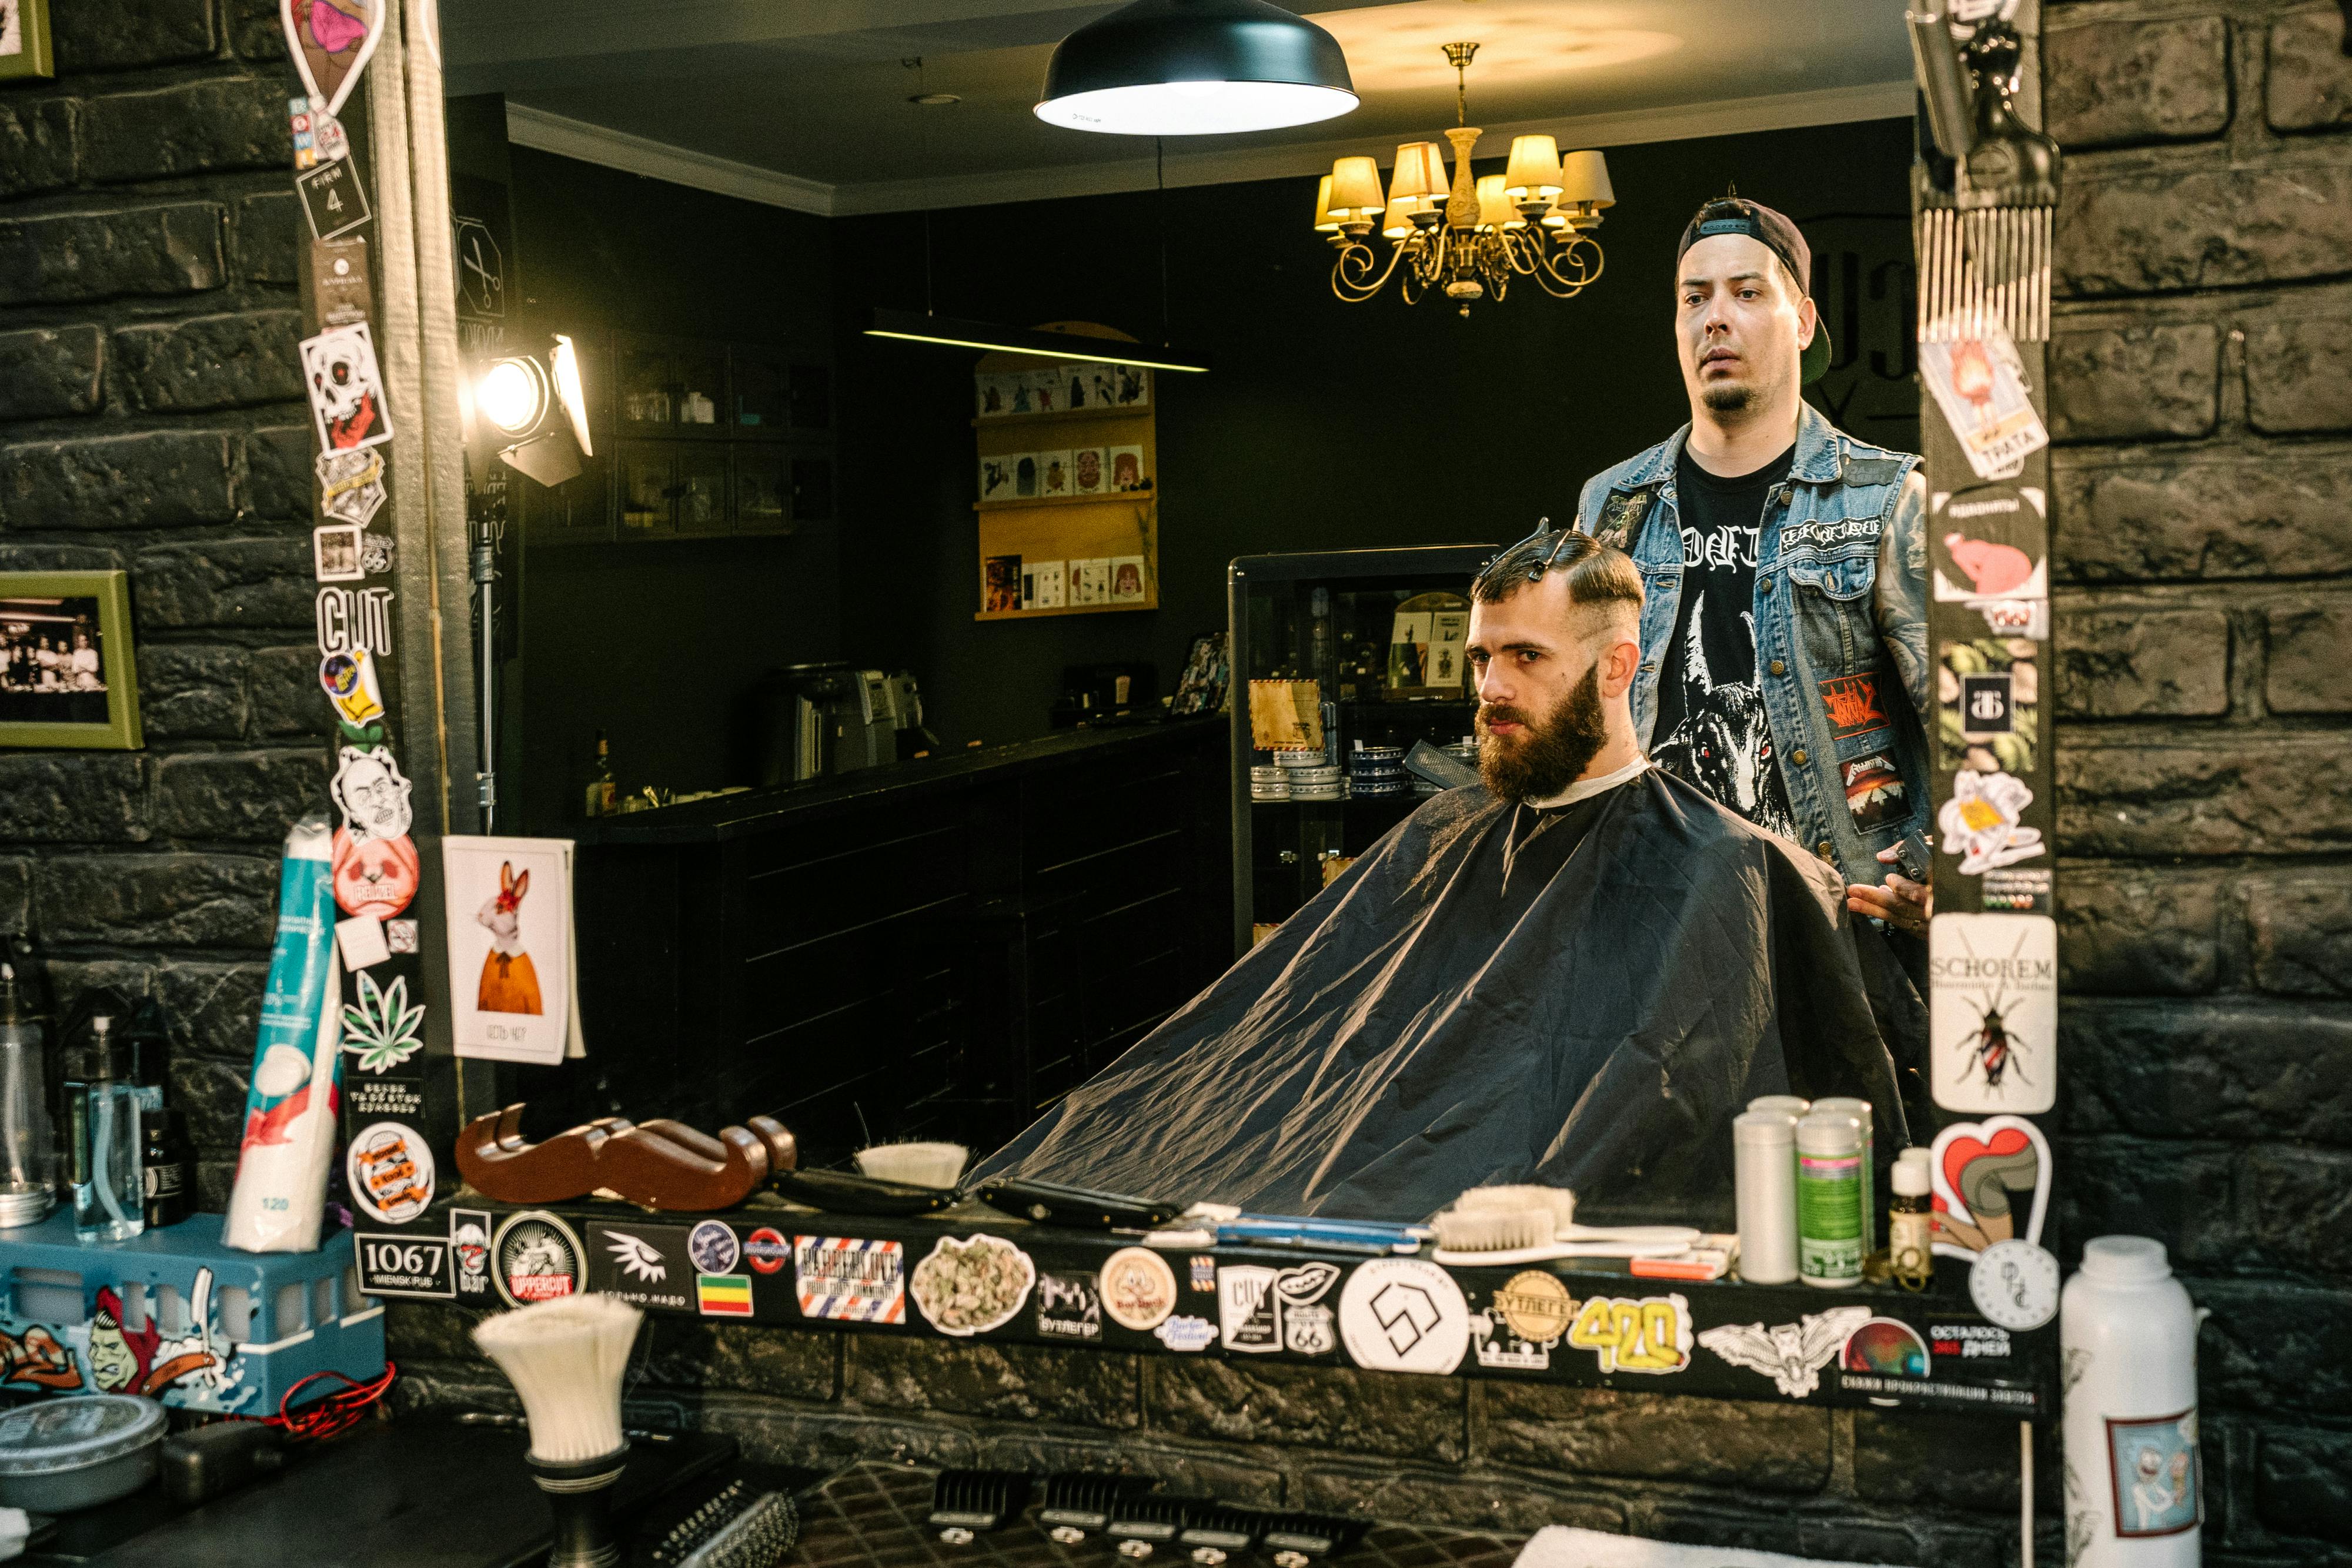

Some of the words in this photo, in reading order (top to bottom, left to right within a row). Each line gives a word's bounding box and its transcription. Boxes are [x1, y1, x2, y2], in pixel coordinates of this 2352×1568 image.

[311, 166, 343, 189] FIRM
[326, 188, 344, 212] 4
[317, 587, 393, 654] CUT
[1931, 957, 2052, 978] SCHOREM
[365, 1243, 443, 1275] 1067
[744, 1244, 790, 1256] UNDERGROUND
[374, 1274, 412, 1286] MIENSK
[413, 1276, 433, 1287] PUB
[510, 1275, 570, 1296] UPPERCUT
[854, 1283, 896, 1300] COMMUNITY
[833, 1303, 874, 1315] SCHOREM
[1294, 1311, 1319, 1319] ROUTE
[1040, 1318, 1099, 1336] БУТЛЕГЕР
[1571, 1298, 1683, 1370] 420
[1930, 1325, 2010, 1340] ОСТАЛОСЬ
[1295, 1328, 1322, 1348] 66
